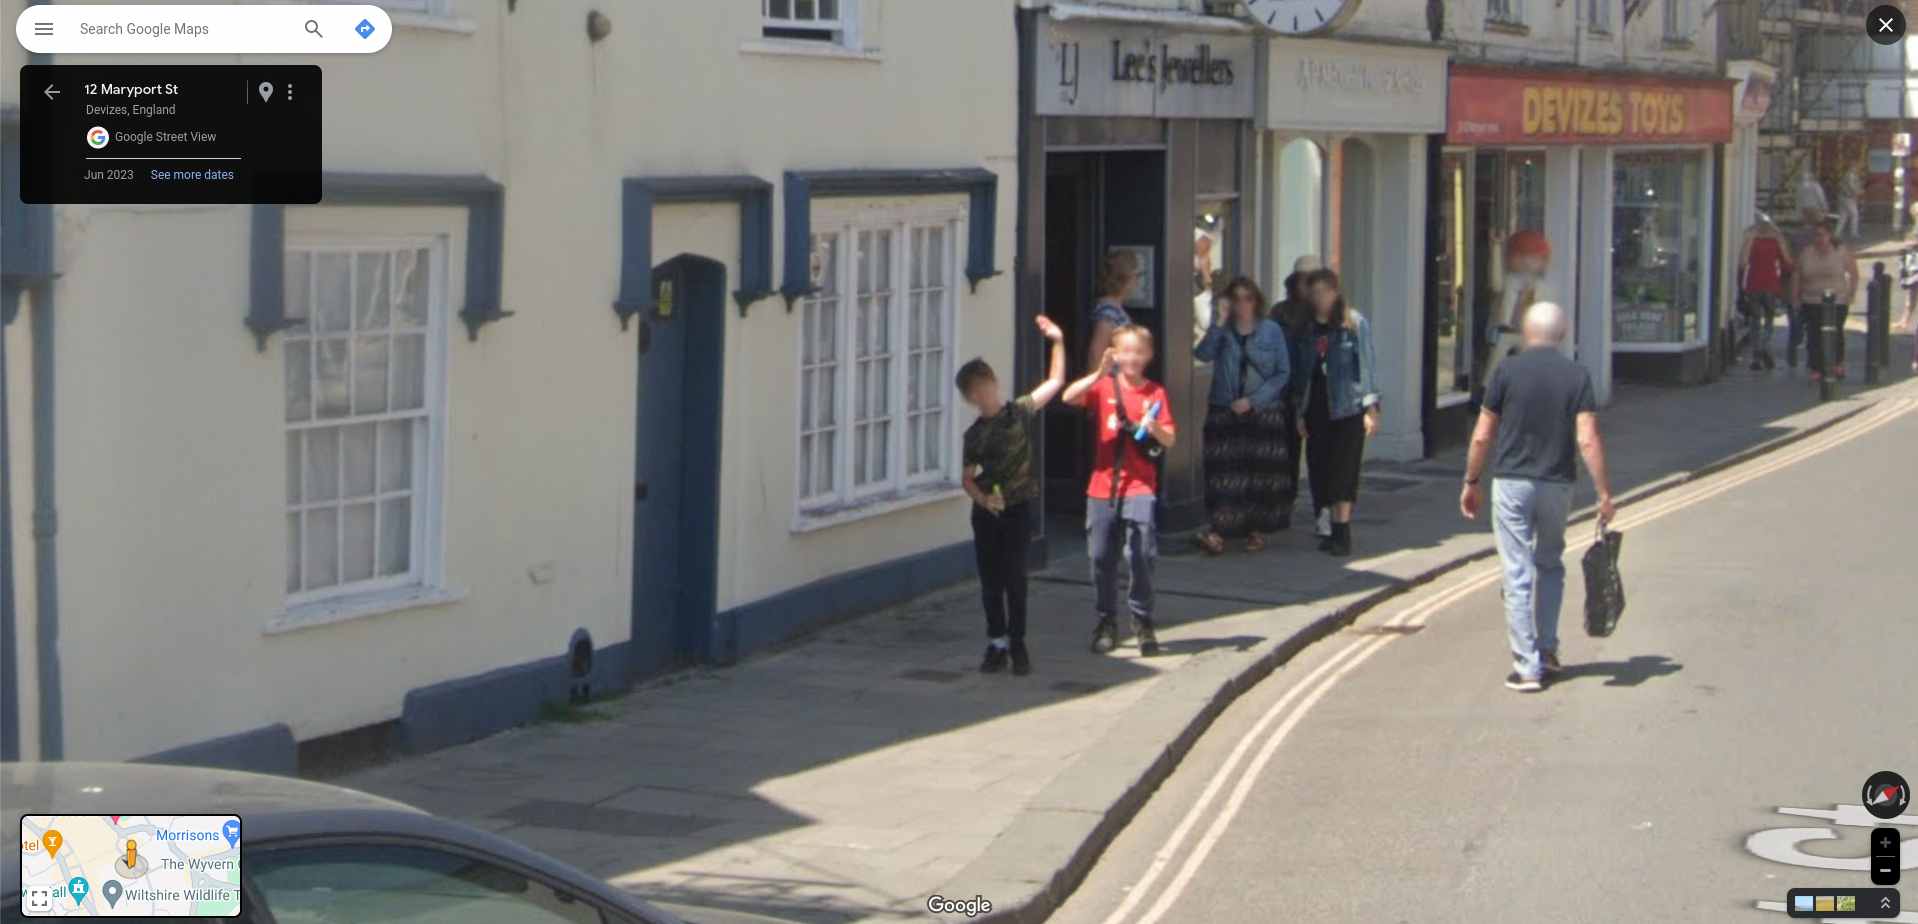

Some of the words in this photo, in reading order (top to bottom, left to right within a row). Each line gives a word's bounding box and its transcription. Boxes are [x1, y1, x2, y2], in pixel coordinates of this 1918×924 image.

[1059, 42, 1080, 105] LJ
[1112, 39, 1157, 82] Lee's
[1160, 43, 1235, 94] Jewellers
[1523, 86, 1624, 135] DEVIZES
[1629, 92, 1687, 135] TOYS
